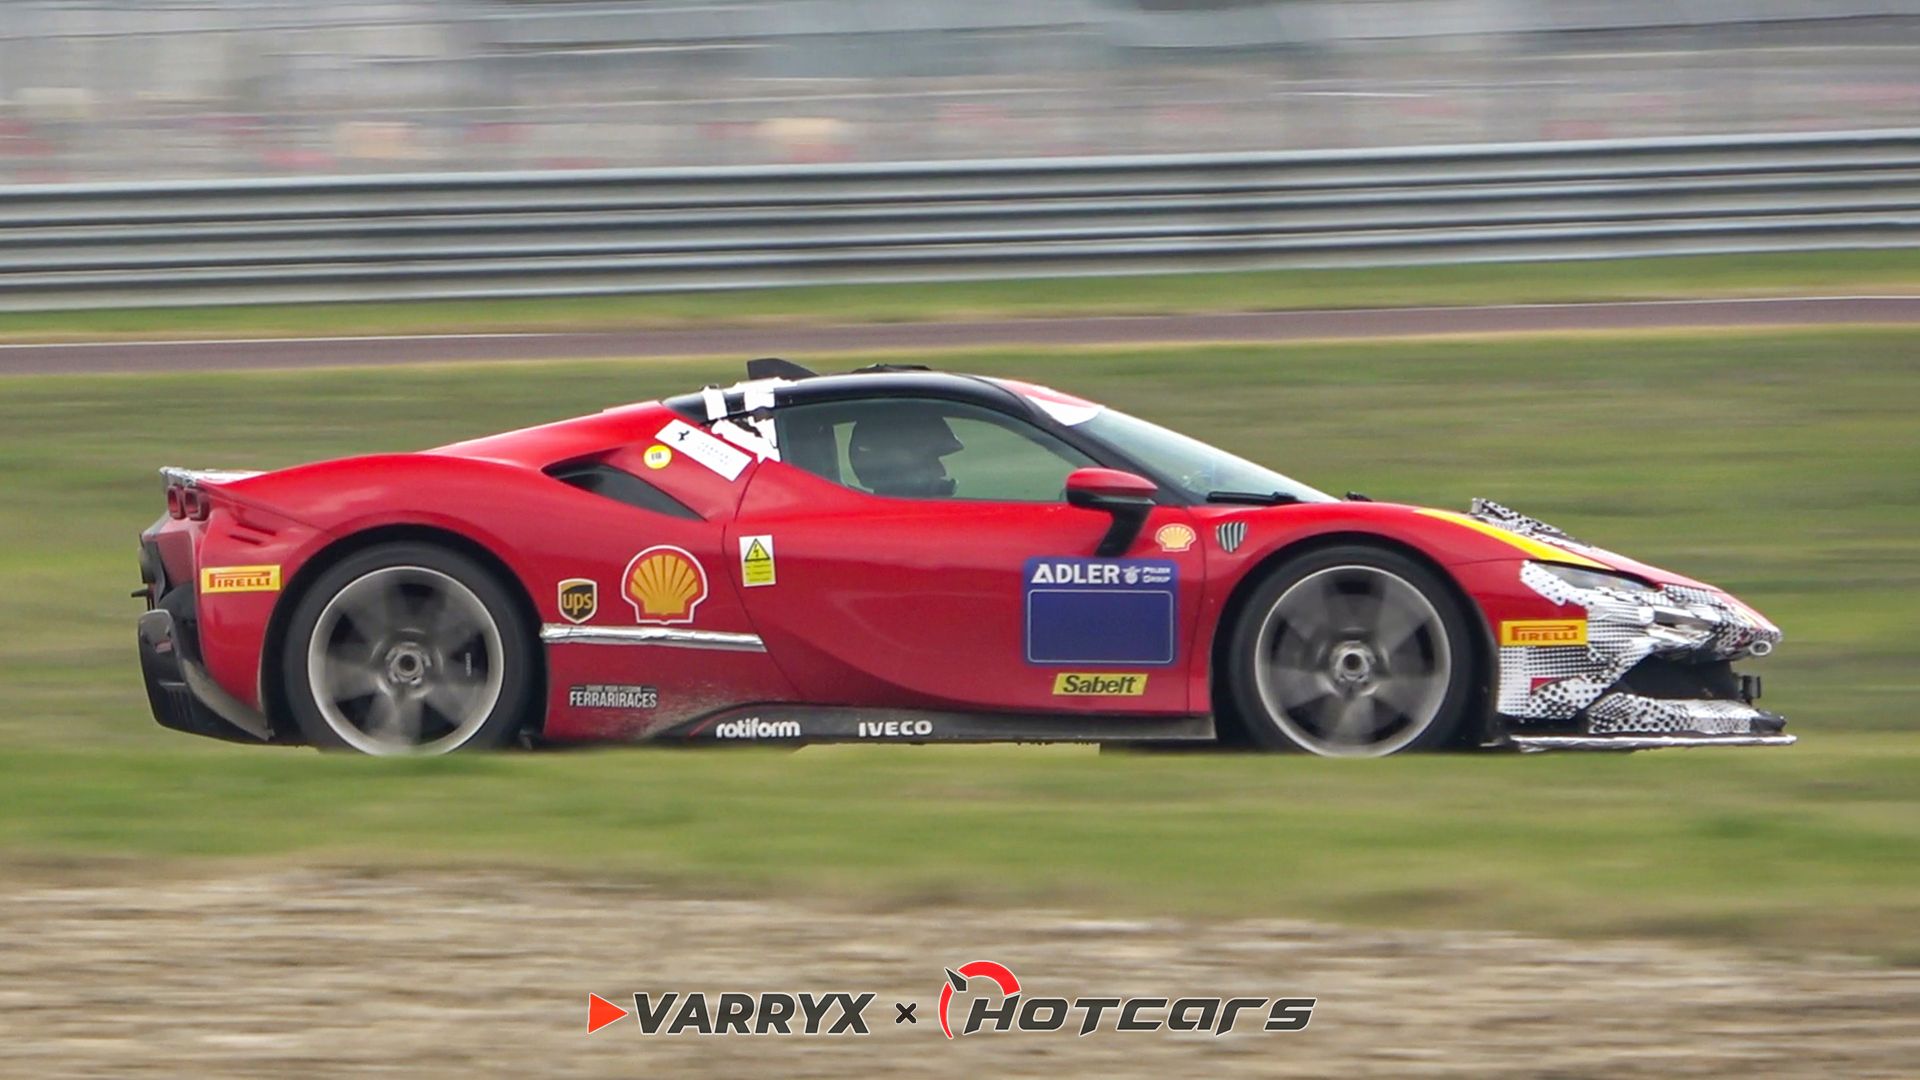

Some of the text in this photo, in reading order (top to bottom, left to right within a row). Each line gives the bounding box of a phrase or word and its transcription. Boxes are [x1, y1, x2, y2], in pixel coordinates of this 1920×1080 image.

[208, 571, 271, 588] PIRELLI
[1030, 563, 1120, 584] ADLER
[562, 593, 593, 615] ups
[1511, 625, 1578, 641] PIRELLI
[1063, 675, 1137, 694] Sabelt
[569, 691, 657, 708] FERRARIRACES
[716, 717, 800, 739] rotiform
[858, 720, 933, 737] IVECO
